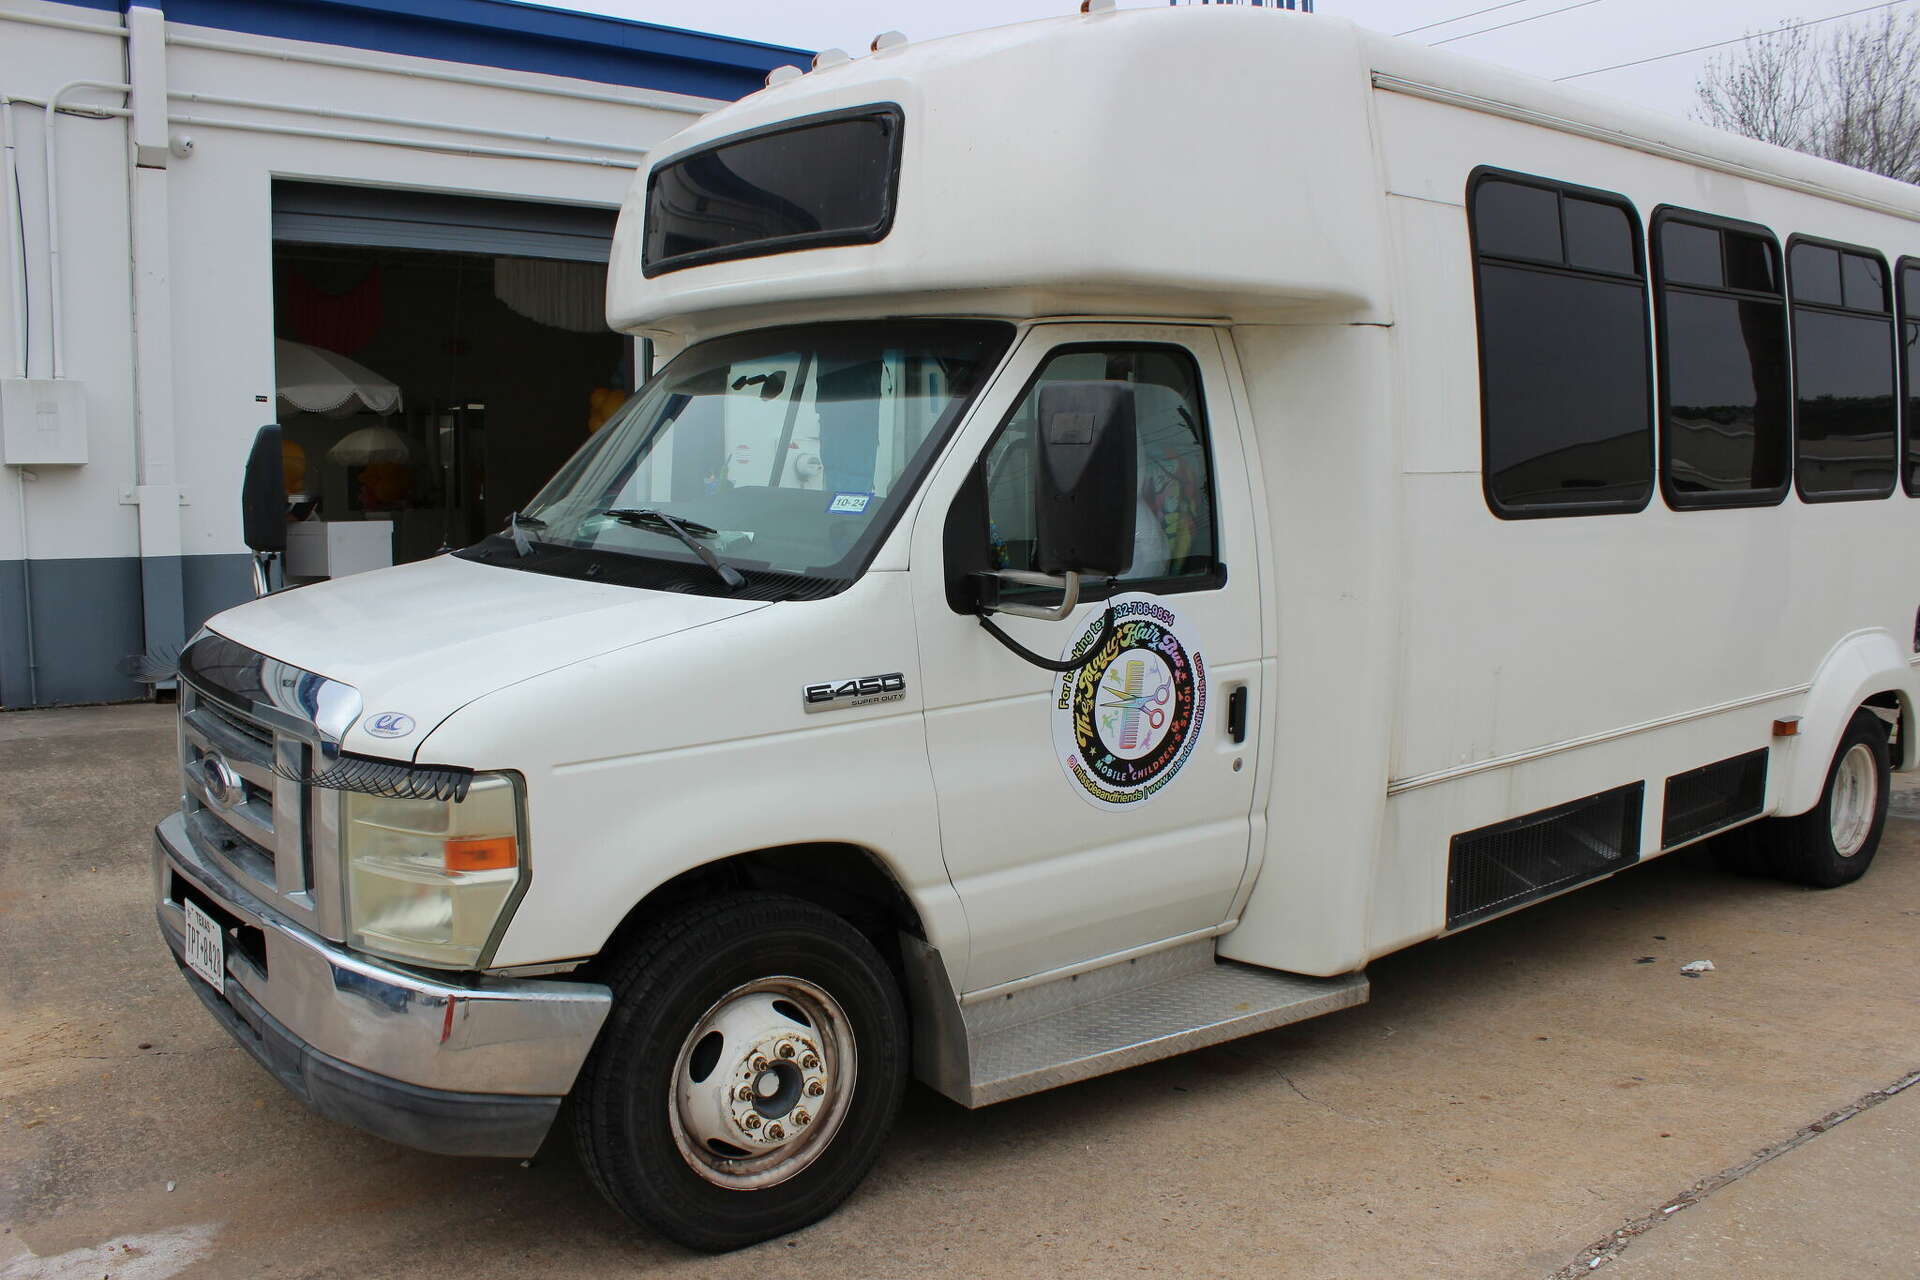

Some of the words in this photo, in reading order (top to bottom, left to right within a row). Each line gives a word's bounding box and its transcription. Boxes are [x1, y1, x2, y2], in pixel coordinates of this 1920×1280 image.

[836, 498, 866, 507] 10-24
[1119, 622, 1163, 648] Hair
[1158, 634, 1185, 668] Bus
[1063, 629, 1095, 683] bking
[1078, 636, 1120, 699] Magic
[851, 697, 880, 706] SUPER
[881, 693, 904, 703] DUTY
[1058, 683, 1072, 709] For
[1076, 699, 1094, 748] The
[1095, 761, 1127, 781] MOBILE
[1131, 733, 1183, 780] CHILDREN'S
[1180, 685, 1192, 728] SALON
[1073, 763, 1143, 804] missdeeandfriends
[195, 911, 211, 933] TEXAS
